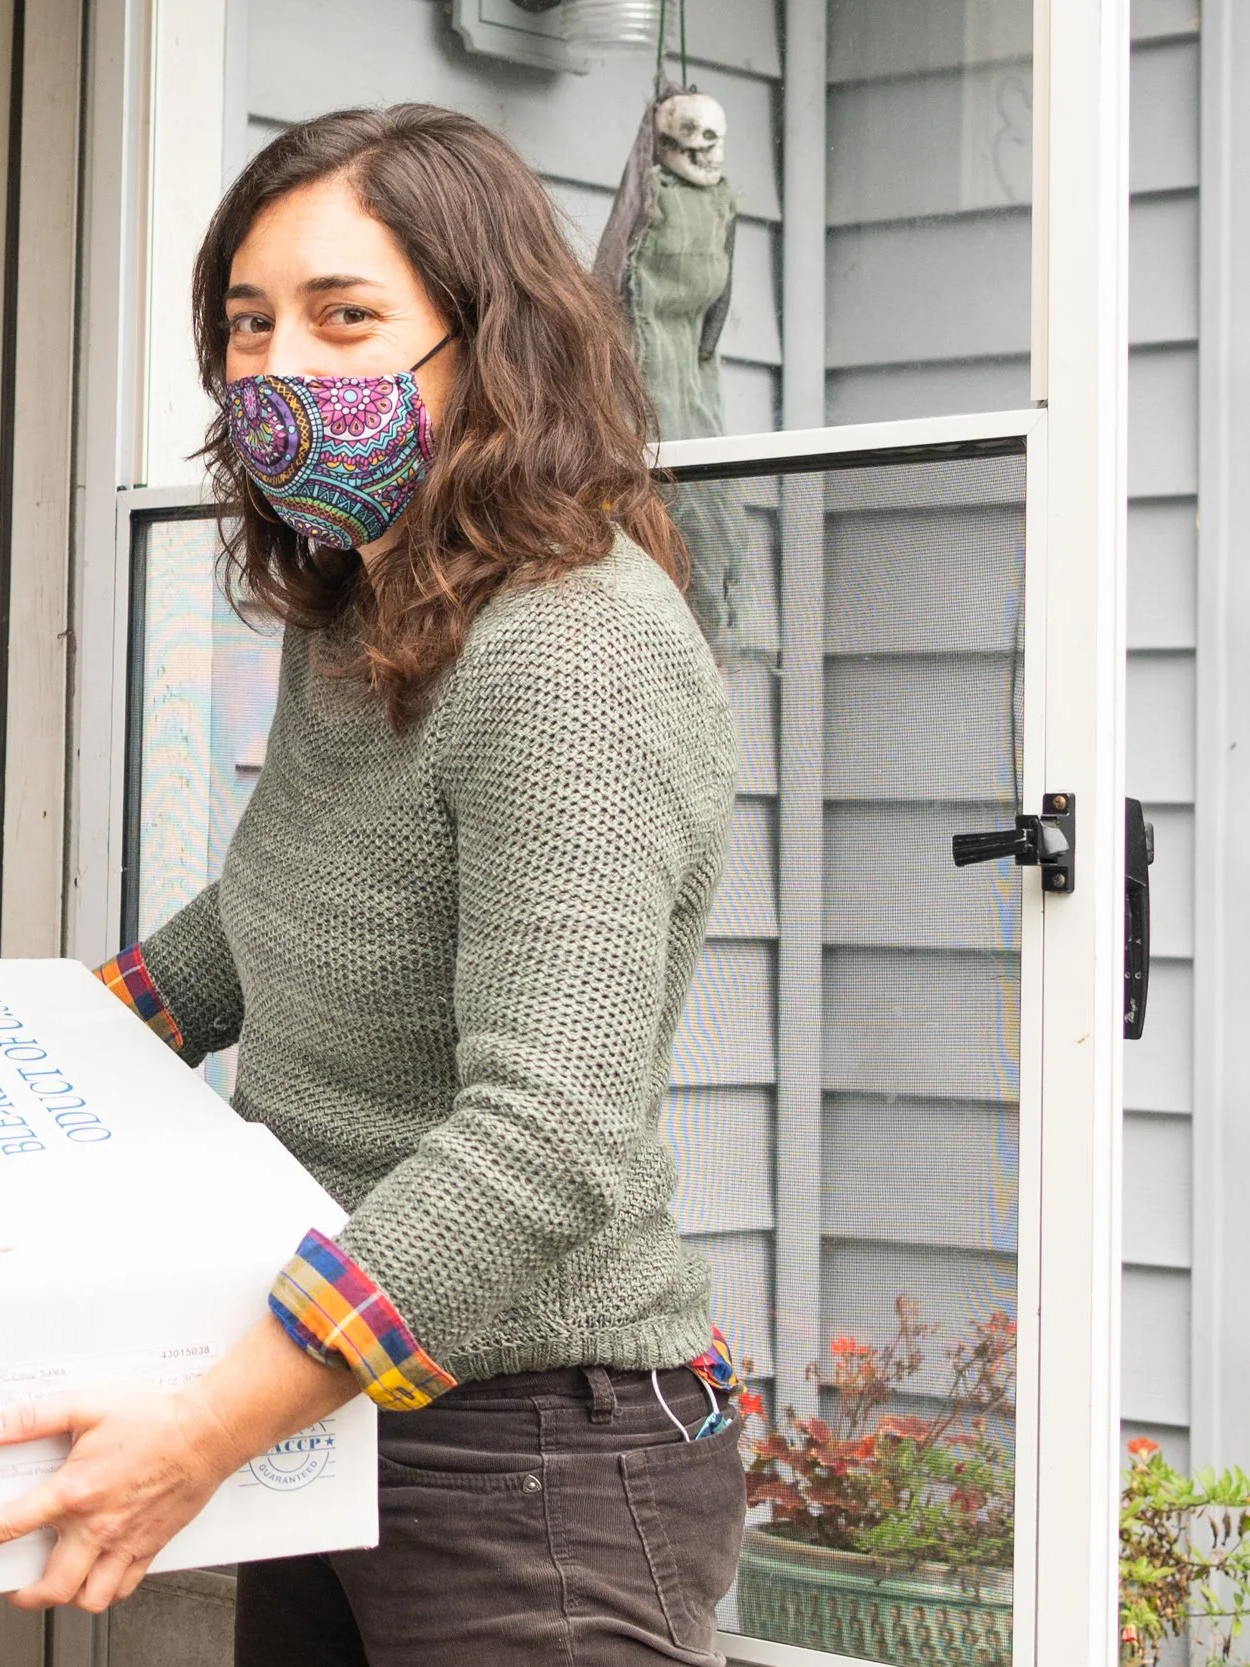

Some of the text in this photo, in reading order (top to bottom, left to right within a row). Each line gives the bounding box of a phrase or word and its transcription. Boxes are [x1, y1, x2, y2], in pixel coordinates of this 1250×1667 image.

[16, 1066, 112, 1143] ODUCT
[270, 1438, 321, 1453] ACCP
[258, 1461, 317, 1484] GUARANTEED
